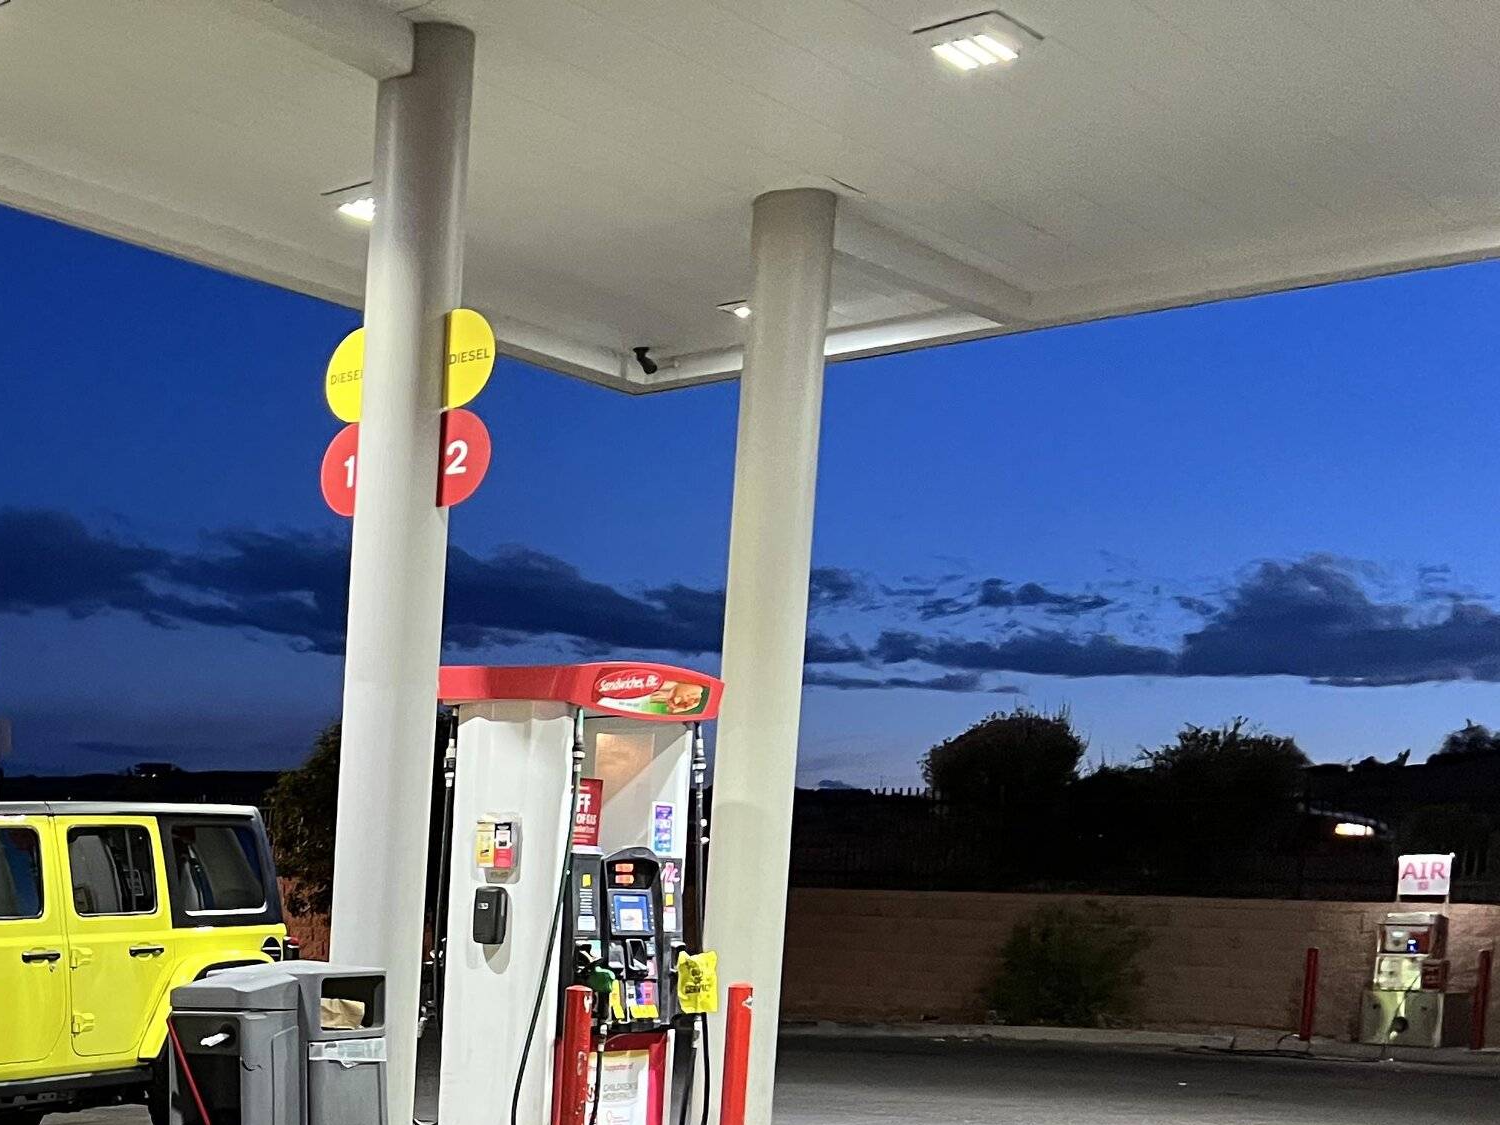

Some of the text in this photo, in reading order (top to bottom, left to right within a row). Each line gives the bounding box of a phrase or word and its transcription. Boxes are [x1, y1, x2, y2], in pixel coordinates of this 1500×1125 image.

[448, 348, 490, 365] DIESEL
[445, 439, 468, 475] 2
[344, 455, 356, 488] 1
[1402, 862, 1445, 880] AIR
